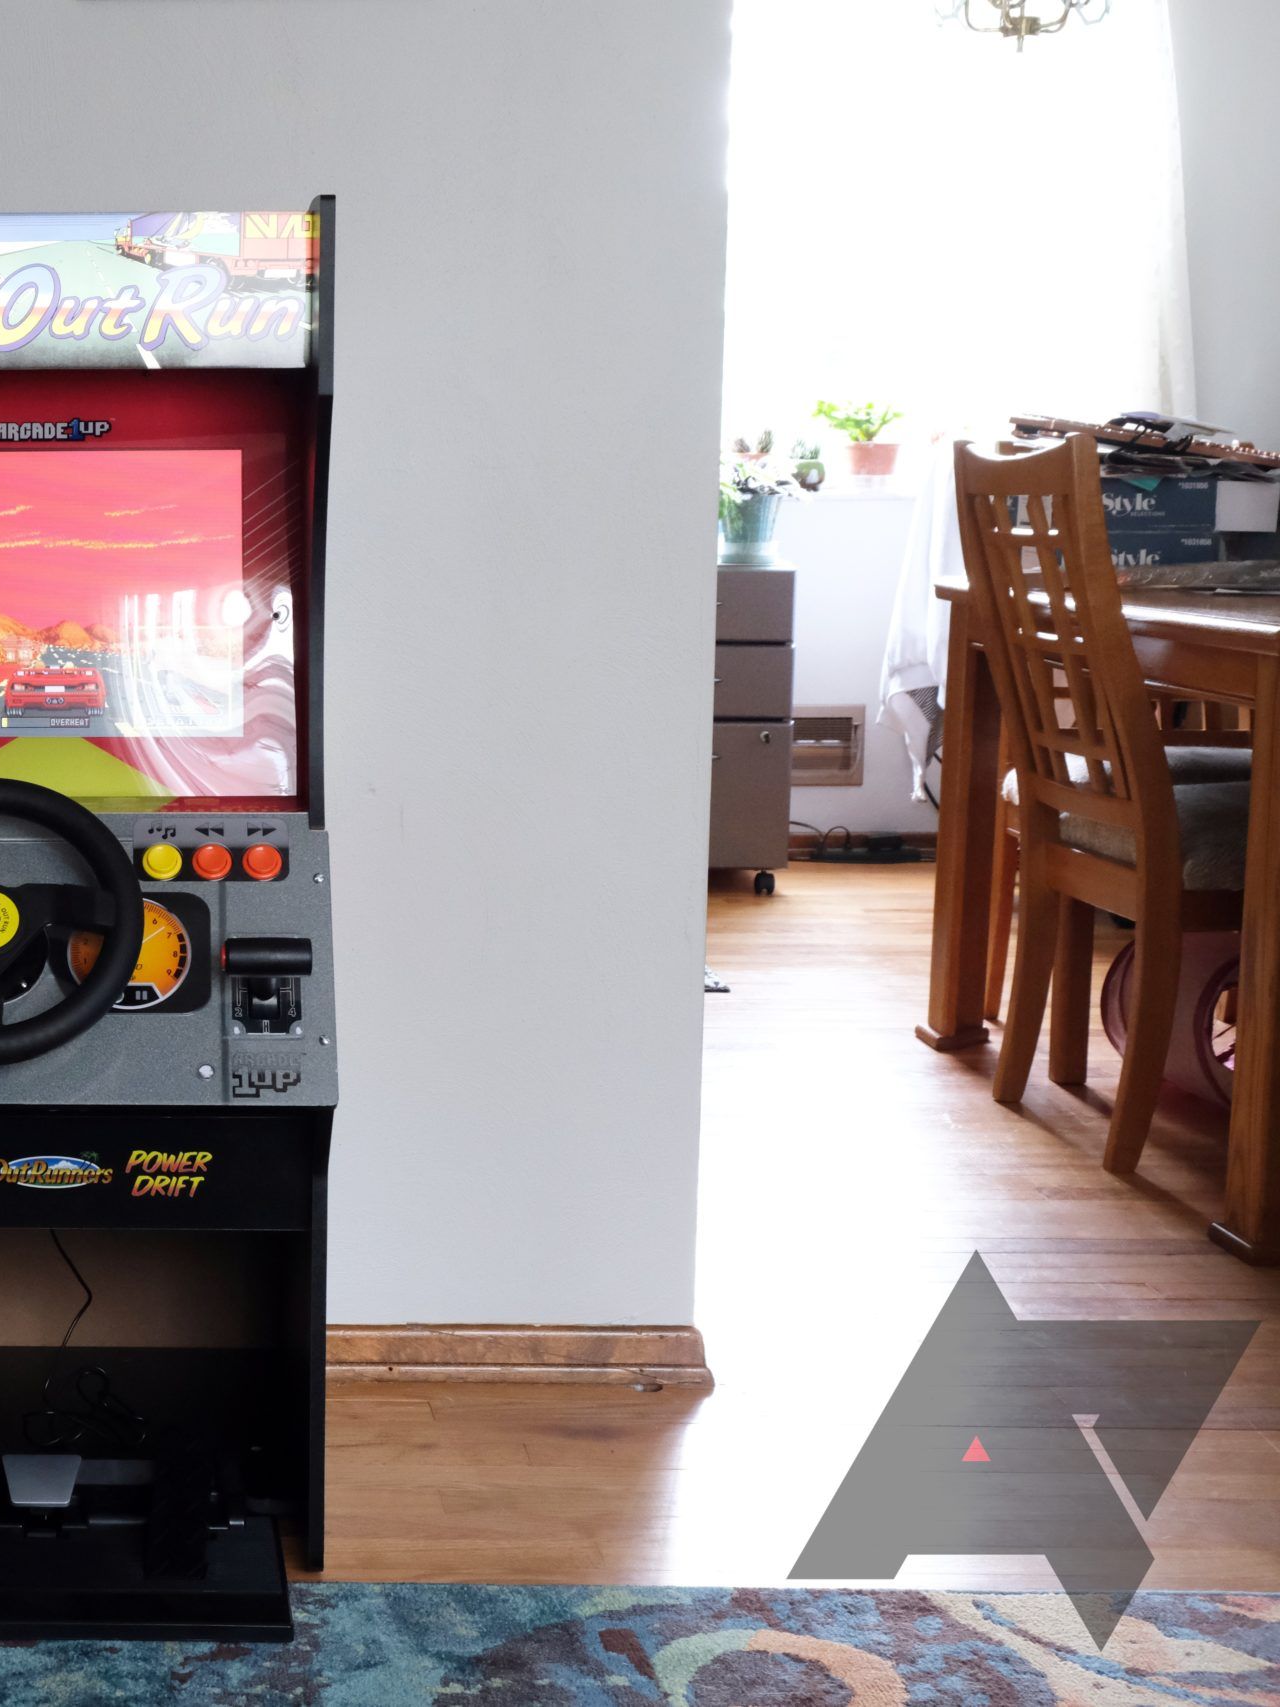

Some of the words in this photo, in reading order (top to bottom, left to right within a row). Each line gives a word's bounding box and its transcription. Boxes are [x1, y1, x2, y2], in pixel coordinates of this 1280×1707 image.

[139, 264, 305, 351] Run
[1102, 493, 1156, 516] Style
[50, 718, 89, 726] OVERHEAT
[1, 907, 10, 920] OUT
[0, 921, 9, 933] RUN
[172, 950, 178, 958] 8
[234, 1007, 242, 1017] 2
[288, 1007, 296, 1017] 4
[233, 1067, 301, 1098] 1UP
[125, 1150, 212, 1174] POWER
[130, 1175, 206, 1198] DRIFT
